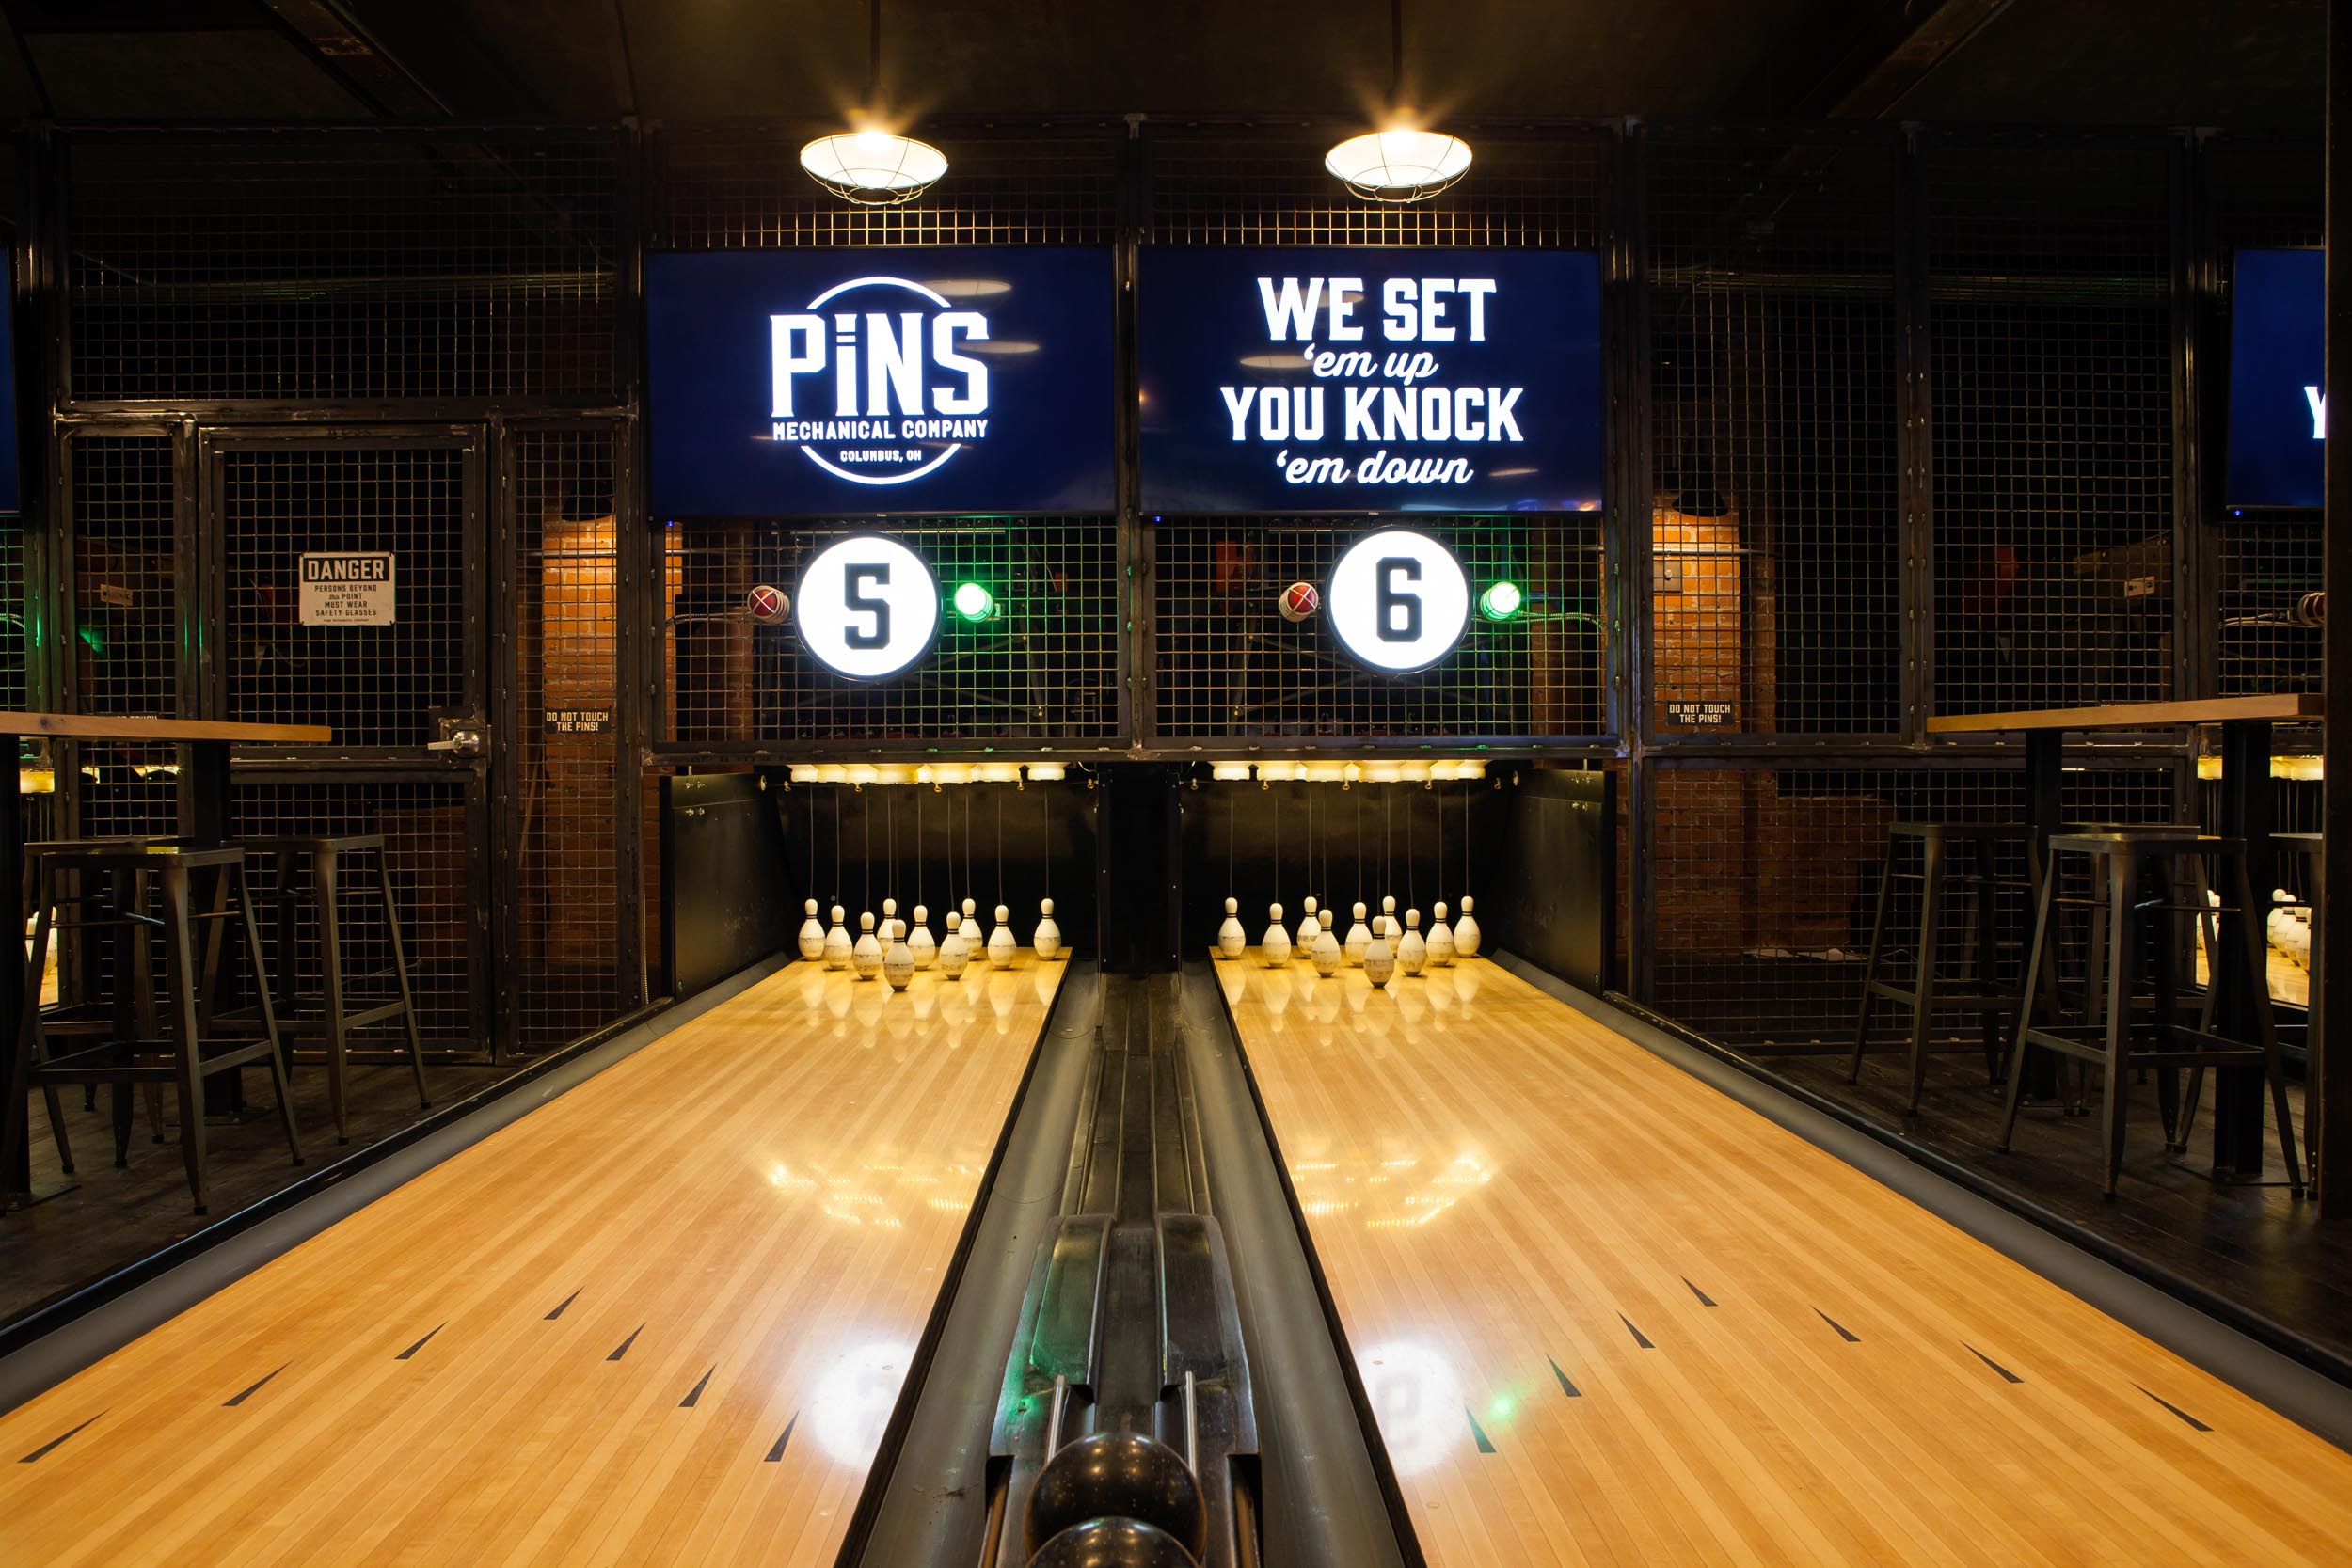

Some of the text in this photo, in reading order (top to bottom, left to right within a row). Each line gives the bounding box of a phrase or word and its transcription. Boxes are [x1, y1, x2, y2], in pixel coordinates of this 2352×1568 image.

[1258, 277, 1497, 341] WE SET
[1384, 351, 1439, 386] up
[1220, 387, 1524, 442] YOU KNOCK
[772, 419, 989, 441] MECHANICAL COMPANY
[840, 450, 922, 463] COLUMBUS, OH
[1357, 450, 1474, 484] down
[308, 559, 385, 580] DANGER
[314, 584, 347, 593] PERSONS
[346, 600, 368, 609] WEAR
[845, 563, 889, 650] 5
[1376, 557, 1422, 642] 6
[315, 609, 342, 617] SAFETY
[546, 712, 609, 721] DO NOT TOUCH
[1669, 704, 1731, 714] DO NOT TOUCH
[556, 721, 599, 732] THE PINS!
[1679, 714, 1722, 723] THE PINS!
